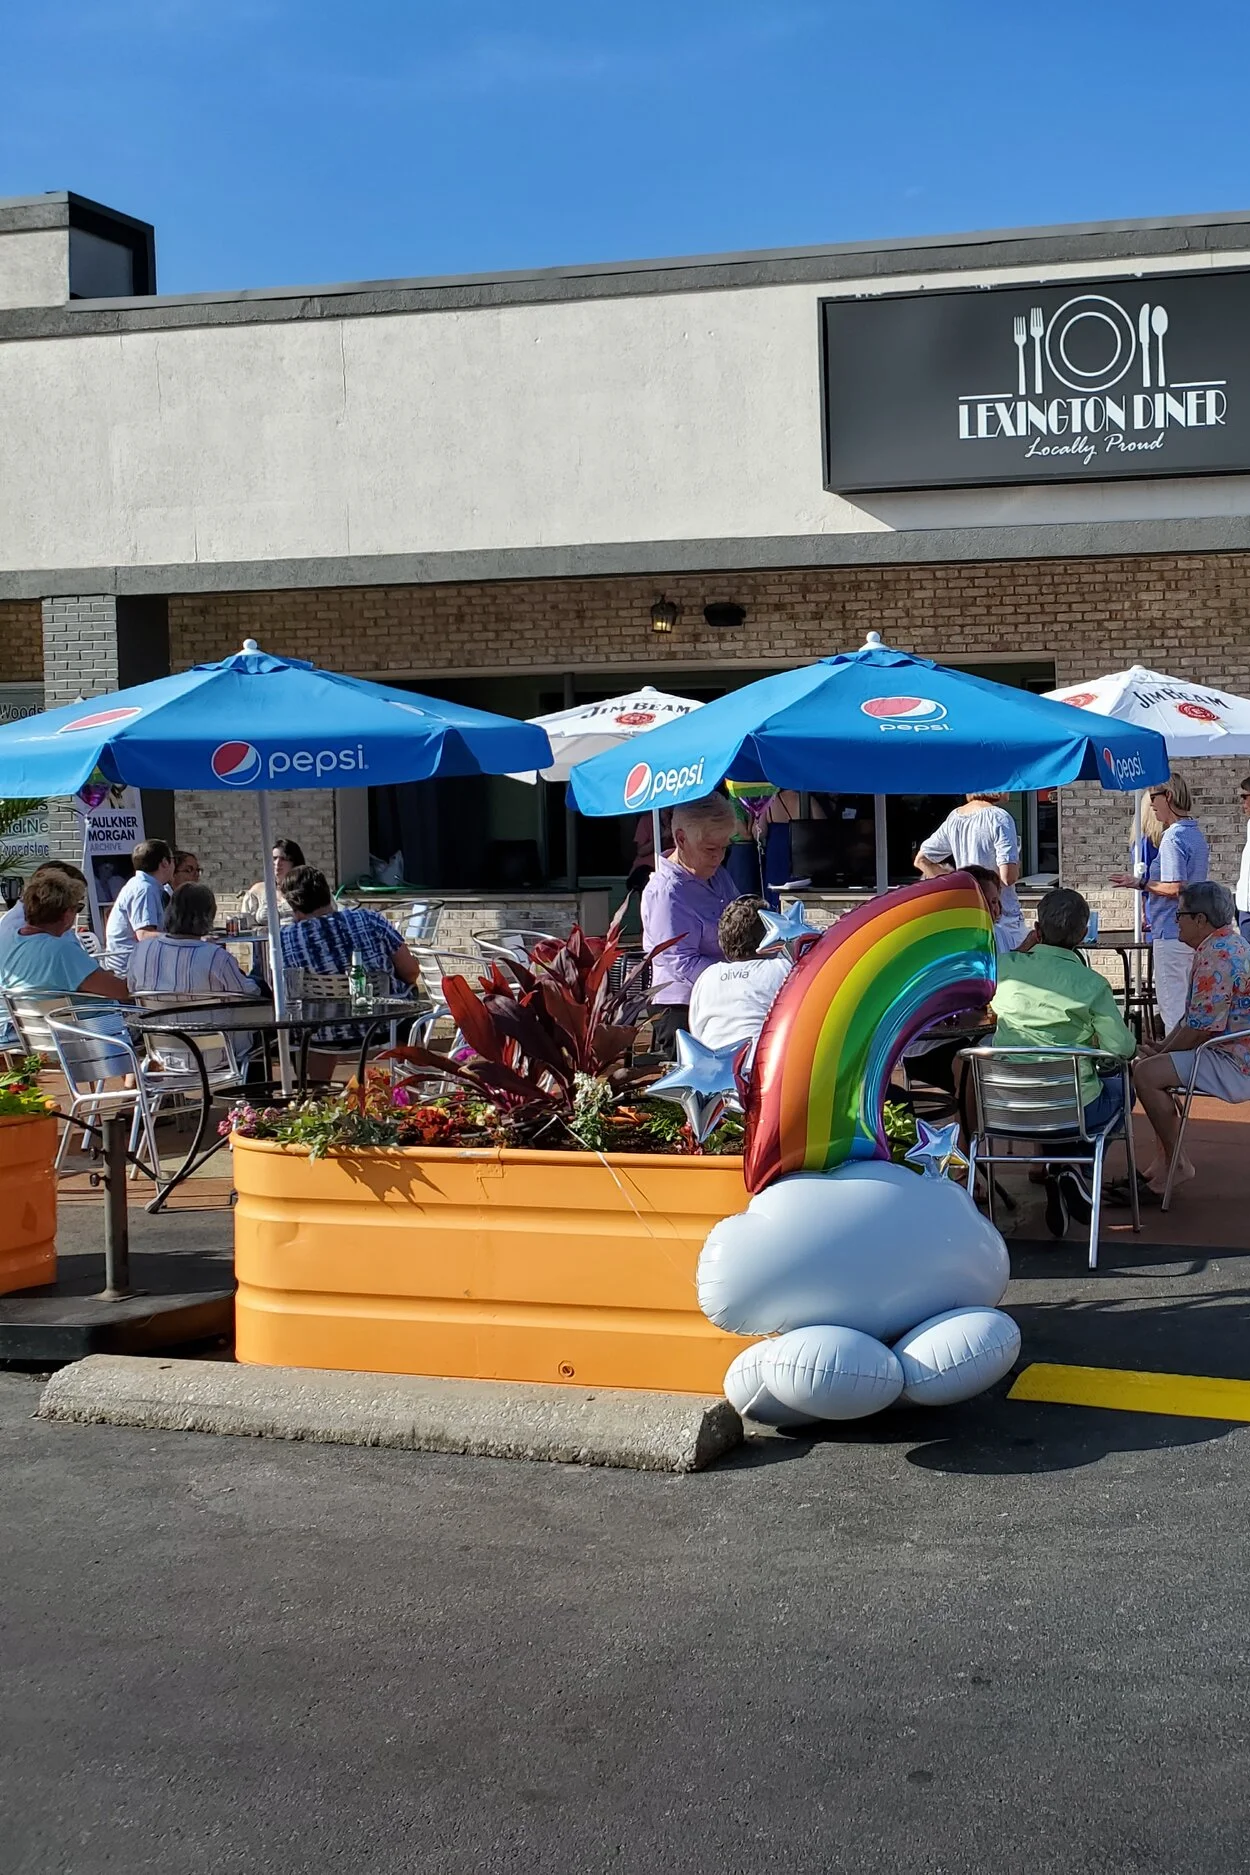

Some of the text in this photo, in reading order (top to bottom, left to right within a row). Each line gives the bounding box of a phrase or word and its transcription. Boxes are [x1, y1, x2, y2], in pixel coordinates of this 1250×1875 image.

[958, 389, 1227, 440] LEXINGTON DINER
[1025, 431, 1165, 465] Locally Proud
[580, 702, 691, 719] JIM BEAM
[1132, 687, 1233, 710] JIM BEAM
[879, 723, 951, 732] pepsi
[268, 744, 366, 779] pepsi
[1116, 750, 1144, 785] pepsi
[650, 755, 705, 801] pepsi
[88, 829, 136, 841] MORGAN
[720, 968, 750, 982] olivia
